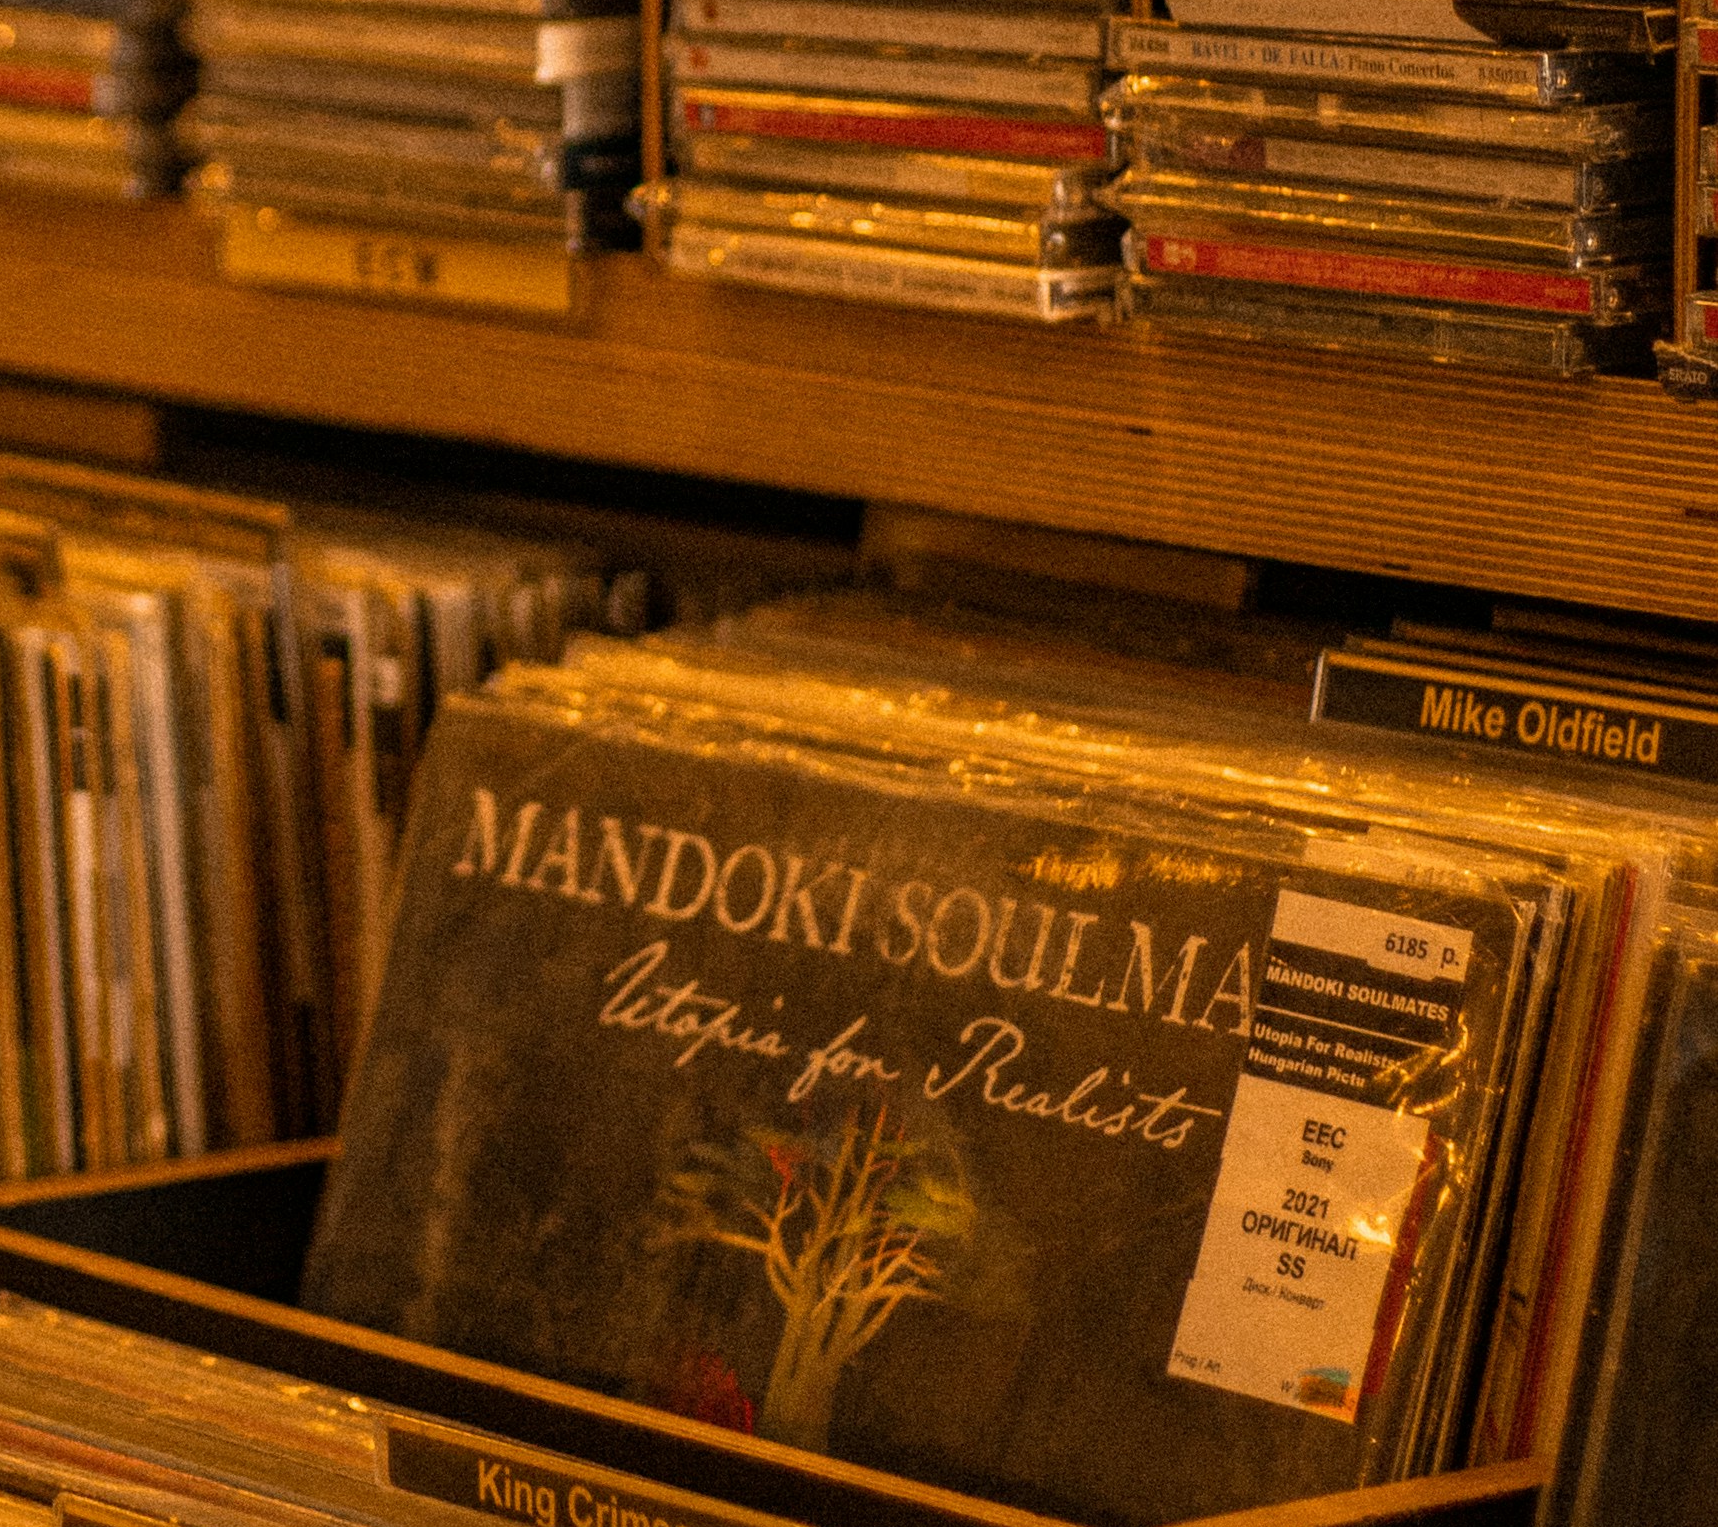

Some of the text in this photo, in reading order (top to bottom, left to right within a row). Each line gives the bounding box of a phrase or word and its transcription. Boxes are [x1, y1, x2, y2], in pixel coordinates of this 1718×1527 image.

[1191, 40, 1239, 61] RAVEL
[1262, 45, 1281, 63] DE
[1346, 53, 1386, 74] Piano
[1420, 683, 1662, 766] Mike Oldfield
[453, 786, 1254, 1039] MANDOKI SOULMA
[1385, 933, 1429, 960] 6185
[1265, 964, 1451, 1023] MANDOKI SOULMATES
[597, 938, 1223, 1150] Utopia for Realists
[1253, 1022, 1303, 1049] Utopia
[1305, 1035, 1333, 1056] For
[1247, 1047, 1324, 1079] Hungarian
[1301, 1150, 1336, 1174] Sony
[1281, 1188, 1331, 1221] 2021
[1241, 1210, 1359, 1262] ОРИГИНАЛ
[1275, 1254, 1307, 1281] SS
